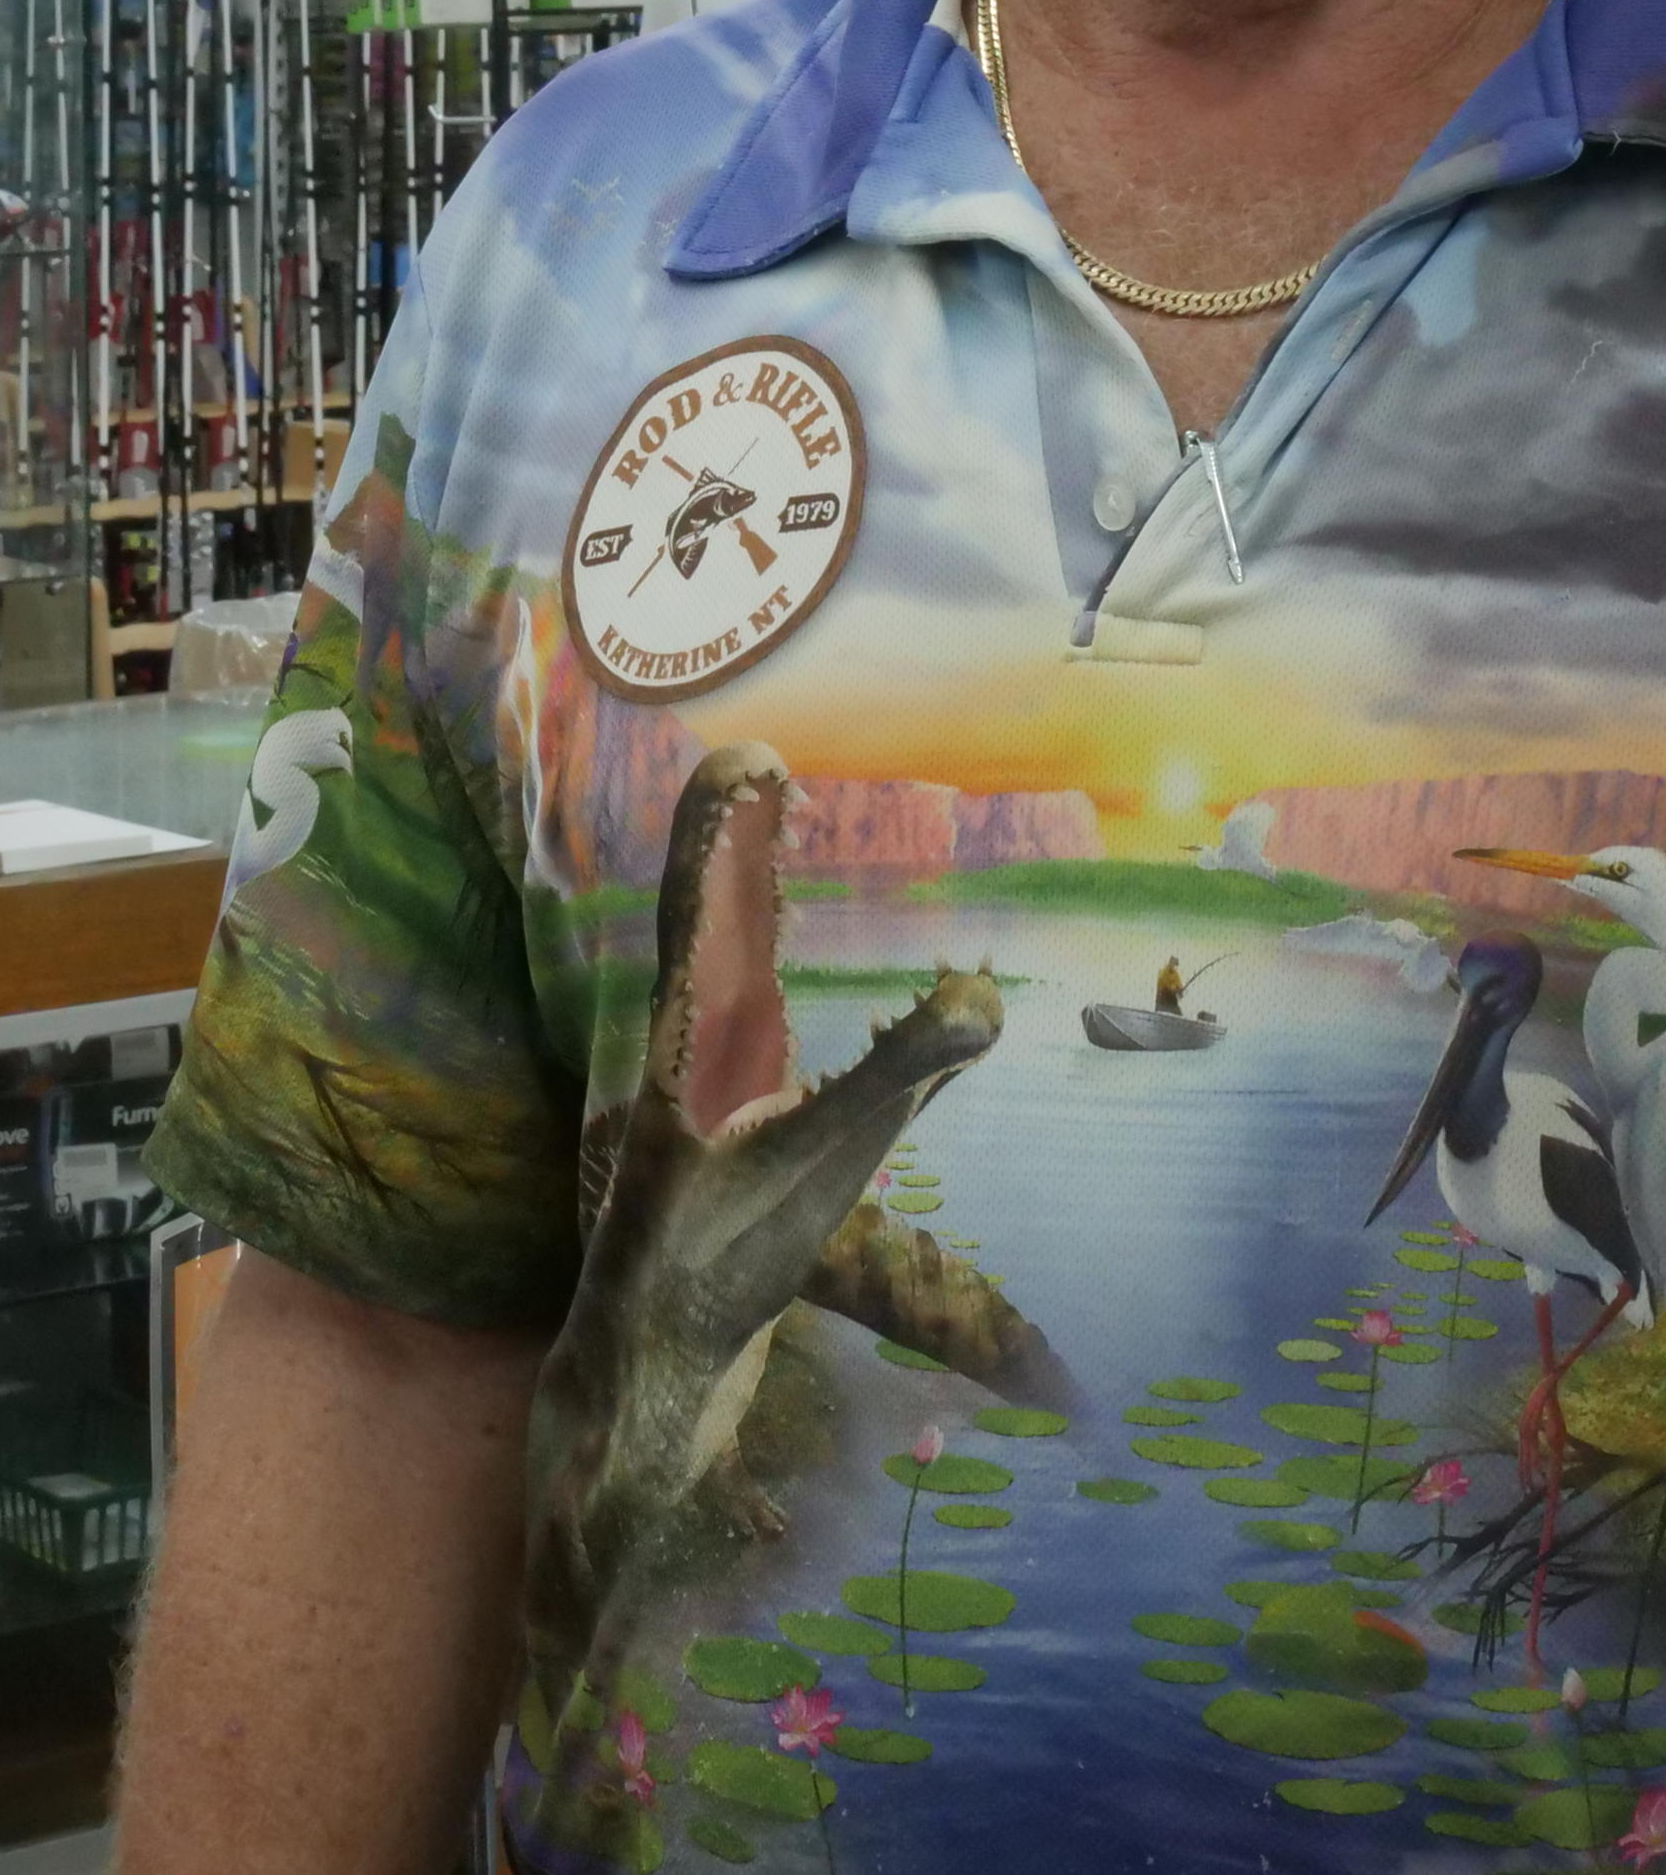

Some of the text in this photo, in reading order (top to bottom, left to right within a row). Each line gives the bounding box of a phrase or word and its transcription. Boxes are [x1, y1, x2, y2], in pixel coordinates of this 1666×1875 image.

[611, 361, 843, 490] ROD & RIFLE
[583, 498, 836, 562] EST 1979
[595, 584, 794, 681] KATHERINE NT
